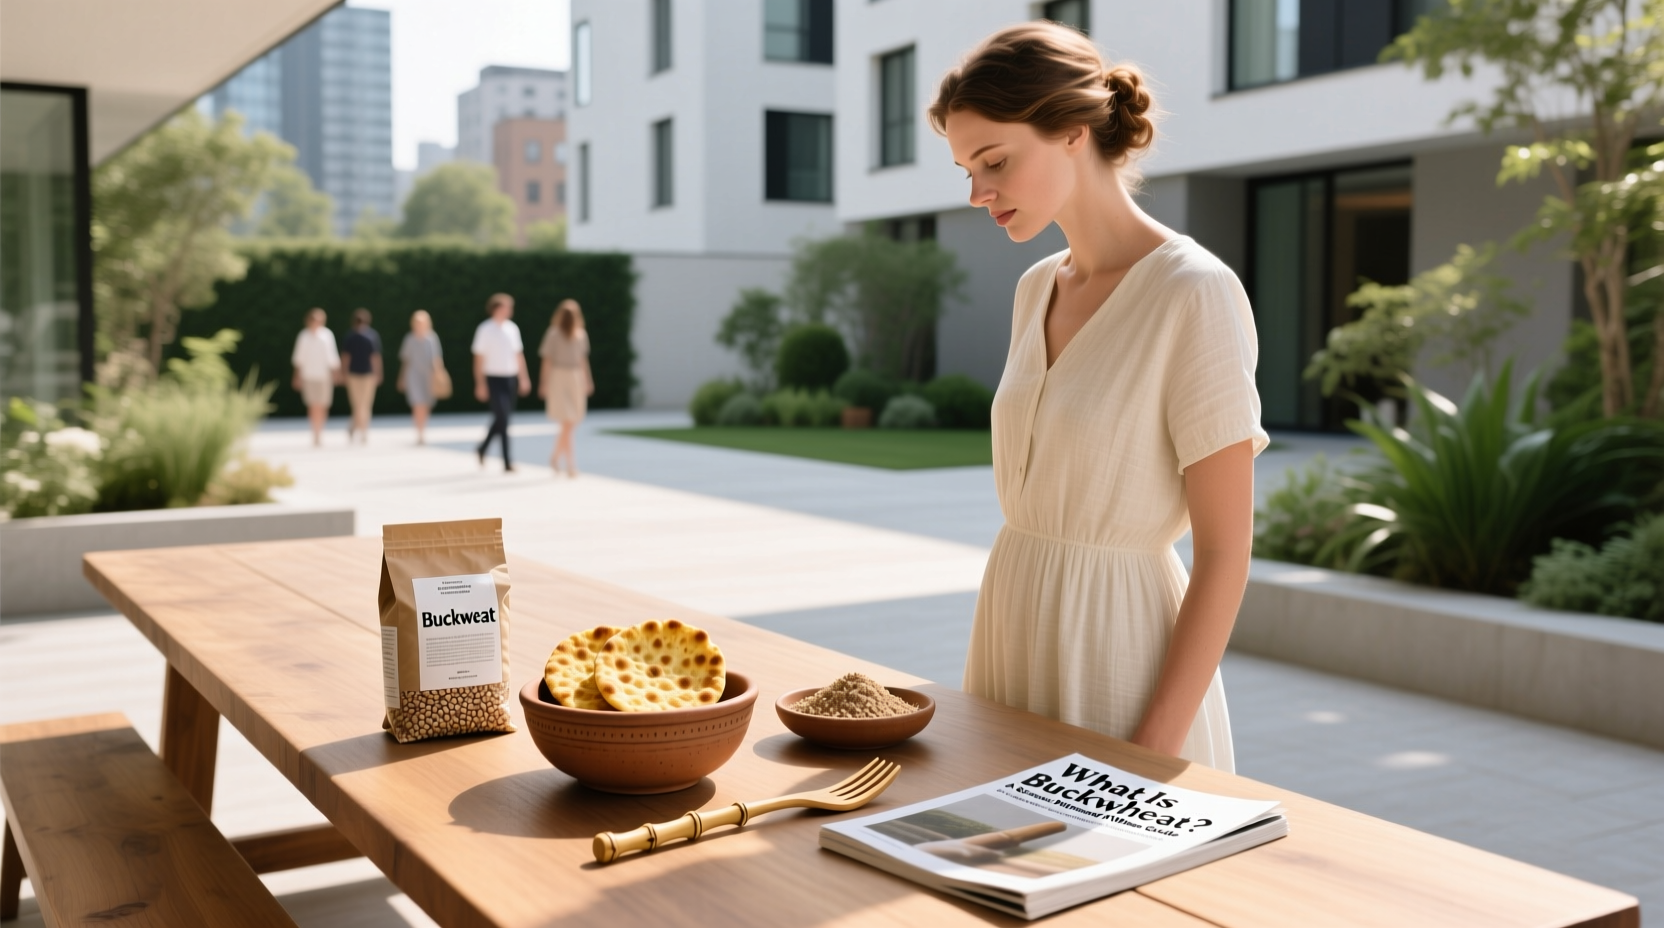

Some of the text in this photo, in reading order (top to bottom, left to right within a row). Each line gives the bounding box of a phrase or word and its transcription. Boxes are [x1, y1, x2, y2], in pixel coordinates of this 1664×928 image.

[422, 607, 496, 628] Buckweat
[1020, 773, 1213, 832] Buckwheat?
[1061, 763, 1145, 800] What
[1144, 791, 1179, 808] Is
